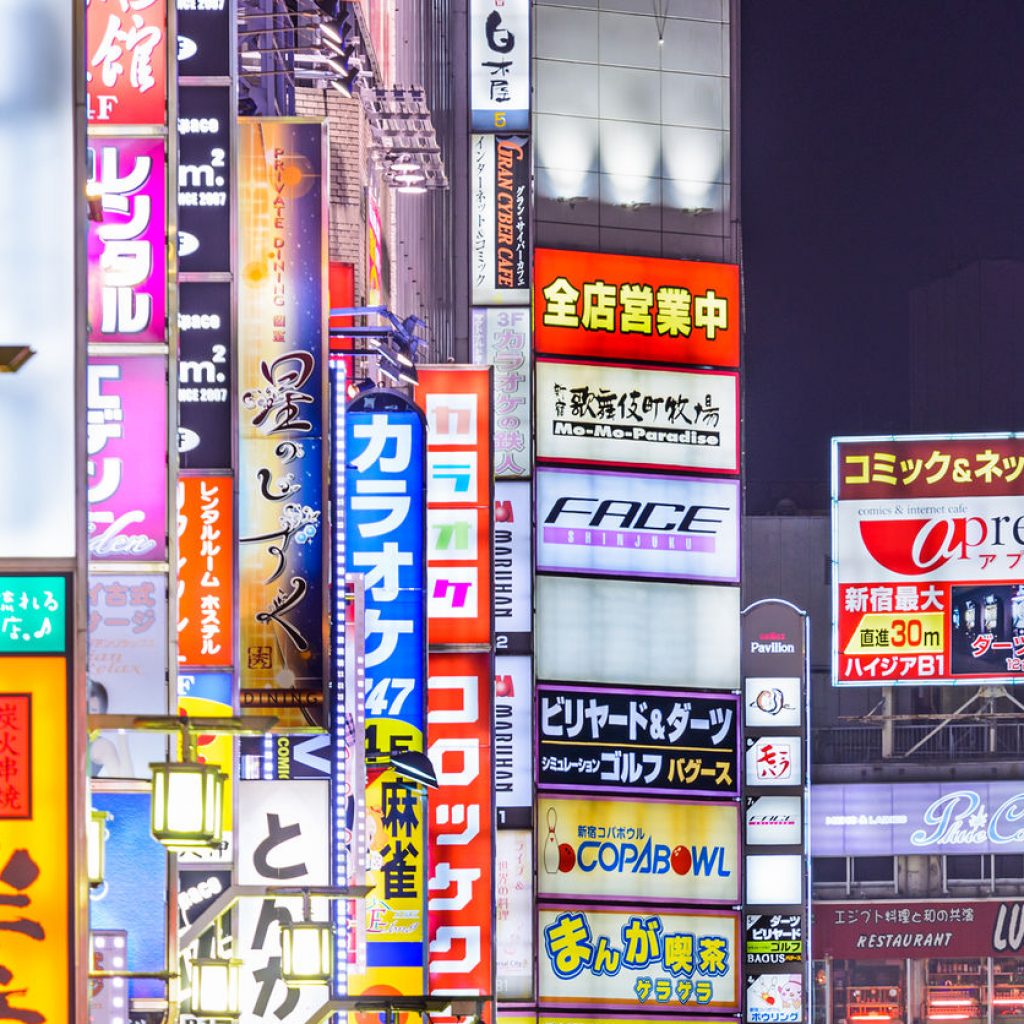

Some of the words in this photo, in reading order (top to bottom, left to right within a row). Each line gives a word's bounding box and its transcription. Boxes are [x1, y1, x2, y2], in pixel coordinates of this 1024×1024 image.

[90, 0, 162, 93] 館
[493, 112, 507, 128] 5
[543, 277, 728, 340] 全店営業中
[554, 421, 719, 446] Mo-Mo-Paradise
[431, 405, 473, 609] カラオケ
[544, 496, 731, 534] FACE
[907, 504, 944, 515] internet
[348, 414, 414, 668] カラオケ
[567, 530, 693, 550] SHINJUKU
[845, 586, 945, 612] 新宿最大
[751, 642, 795, 653] Pavilion
[844, 654, 945, 678] ハイジアB1
[243, 692, 319, 709] DINING
[542, 697, 733, 746] ビリヤード&ダーツ
[600, 752, 663, 785] ゴルフ
[668, 758, 733, 787] バグース
[380, 777, 419, 899] 麻雀
[752, 926, 801, 941] ビリヤード
[770, 914, 800, 927] ダーツ
[548, 913, 731, 982] まんが喫茶
[856, 931, 953, 949] RESTAURANT
[634, 977, 714, 1005] ゲラゲラ
